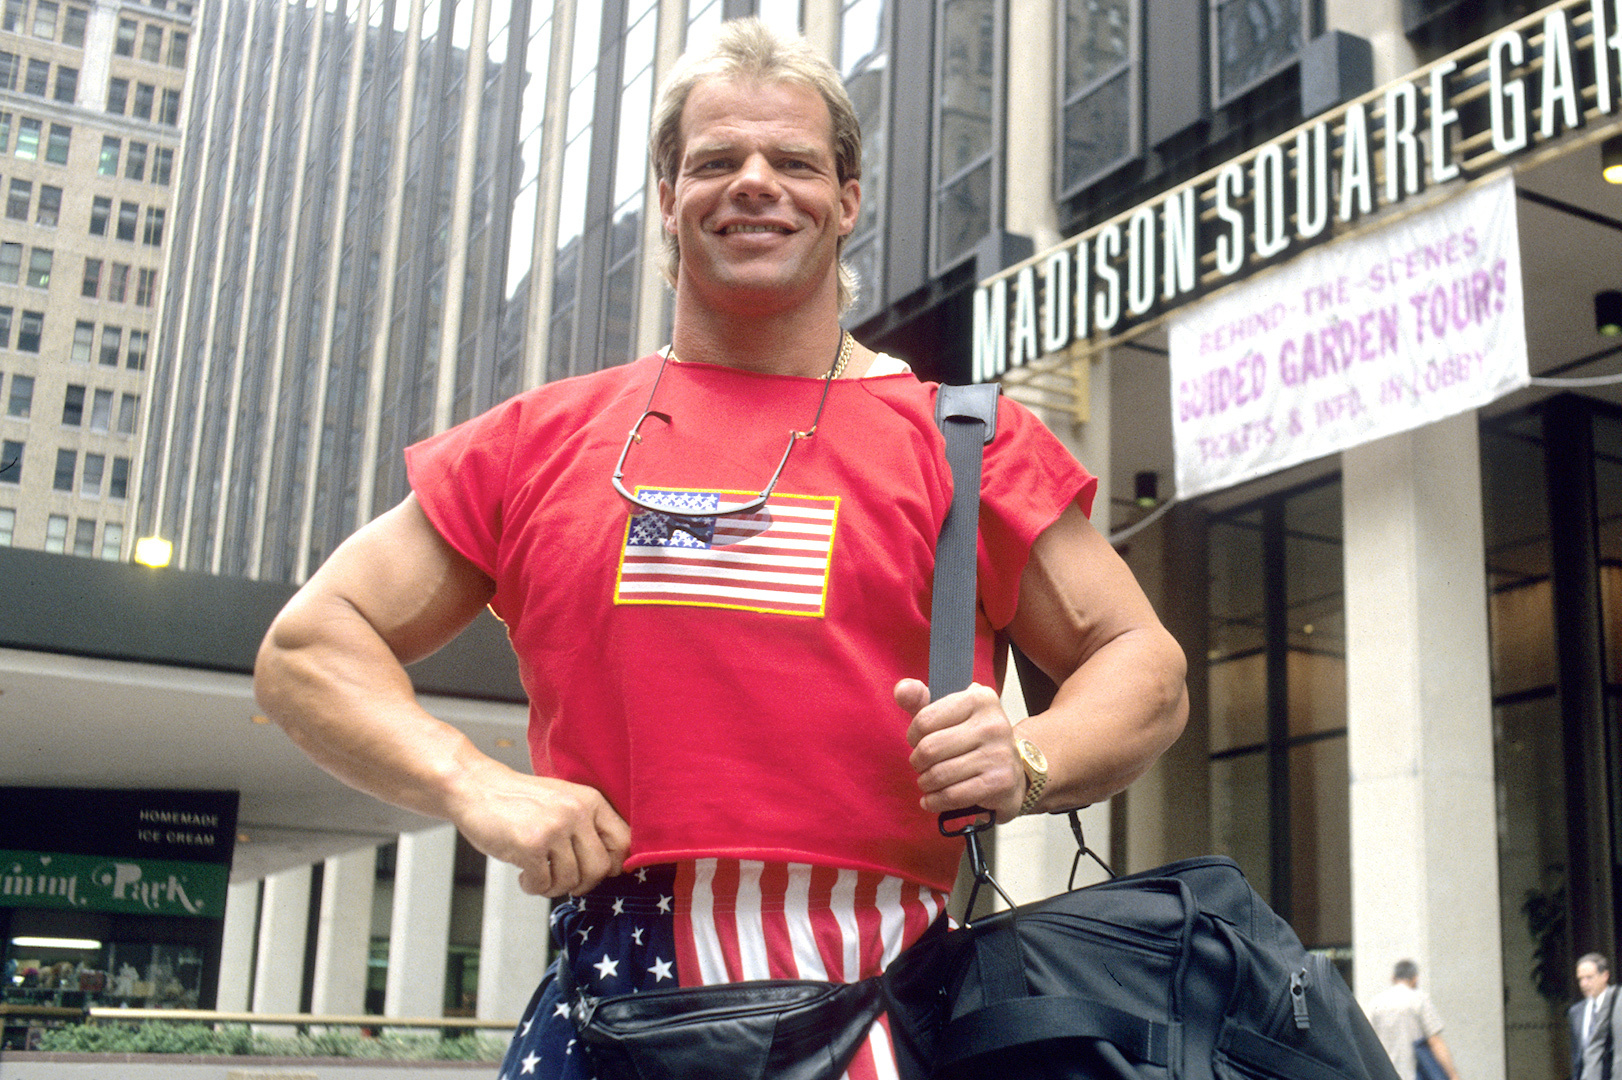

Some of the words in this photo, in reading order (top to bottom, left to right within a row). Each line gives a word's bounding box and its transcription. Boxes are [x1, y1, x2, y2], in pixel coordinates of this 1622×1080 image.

[972, 186, 1196, 384] MADISON
[1216, 60, 1460, 276] SQUARE
[1178, 351, 1267, 423] GUIDED
[1279, 303, 1399, 388] GARDEN
[138, 828, 161, 843] ICE
[166, 831, 215, 845] CREAM
[139, 810, 219, 827] HOMEMADE
[92, 862, 205, 914] Park
